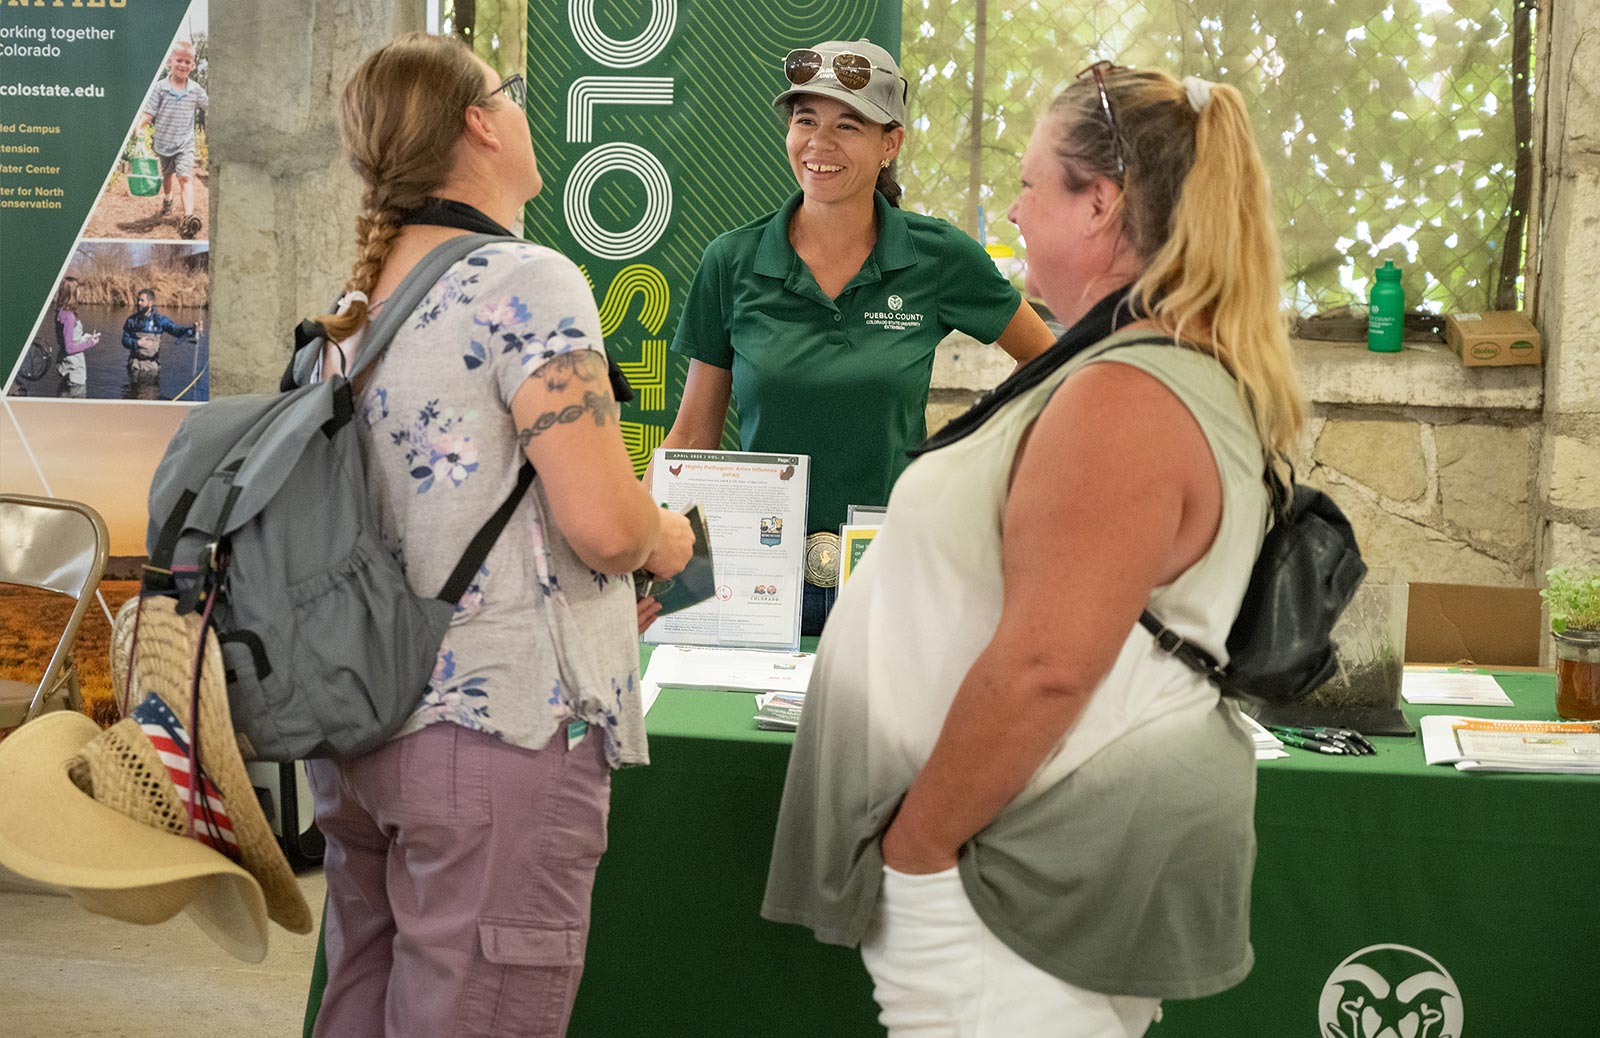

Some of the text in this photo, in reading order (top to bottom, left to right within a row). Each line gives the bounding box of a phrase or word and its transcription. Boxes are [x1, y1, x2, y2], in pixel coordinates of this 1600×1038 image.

[0, 25, 115, 42] orking together
[0, 83, 104, 97] colostate.edu
[19, 124, 60, 135] Campus
[0, 164, 60, 174] ater Center
[17, 187, 32, 196] for
[35, 187, 64, 196] North
[895, 313, 924, 321] COUNTY
[704, 465, 734, 473] Pathogenic
